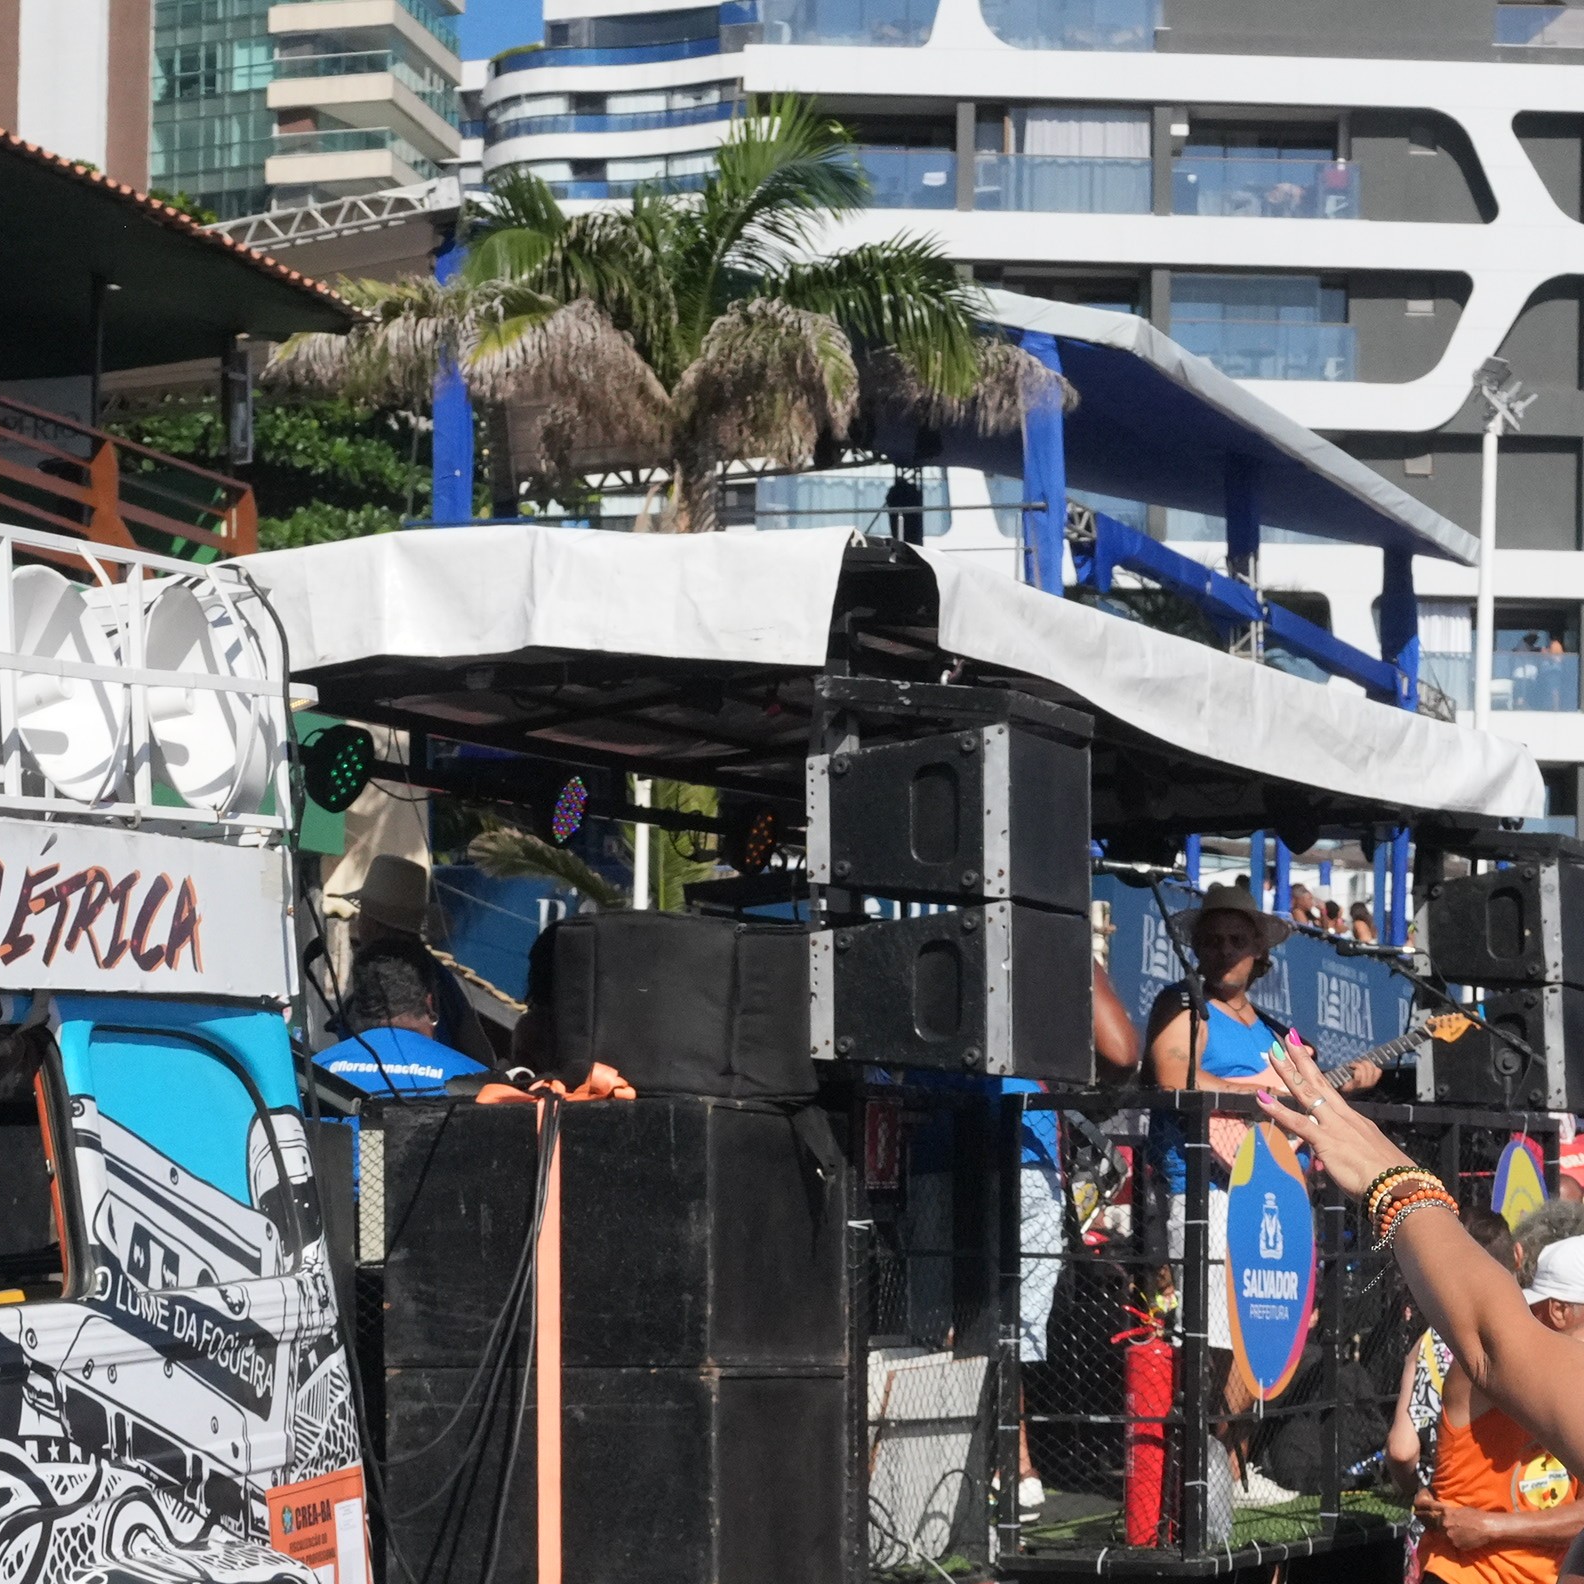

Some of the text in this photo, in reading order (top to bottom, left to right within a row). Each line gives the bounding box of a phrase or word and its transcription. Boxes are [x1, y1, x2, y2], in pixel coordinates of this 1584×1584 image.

[1243, 1268, 1298, 1300] SALVADOR
[116, 1273, 168, 1331] LUME
[174, 1305, 199, 1348] DA
[295, 1499, 332, 1530] CREA-BA
